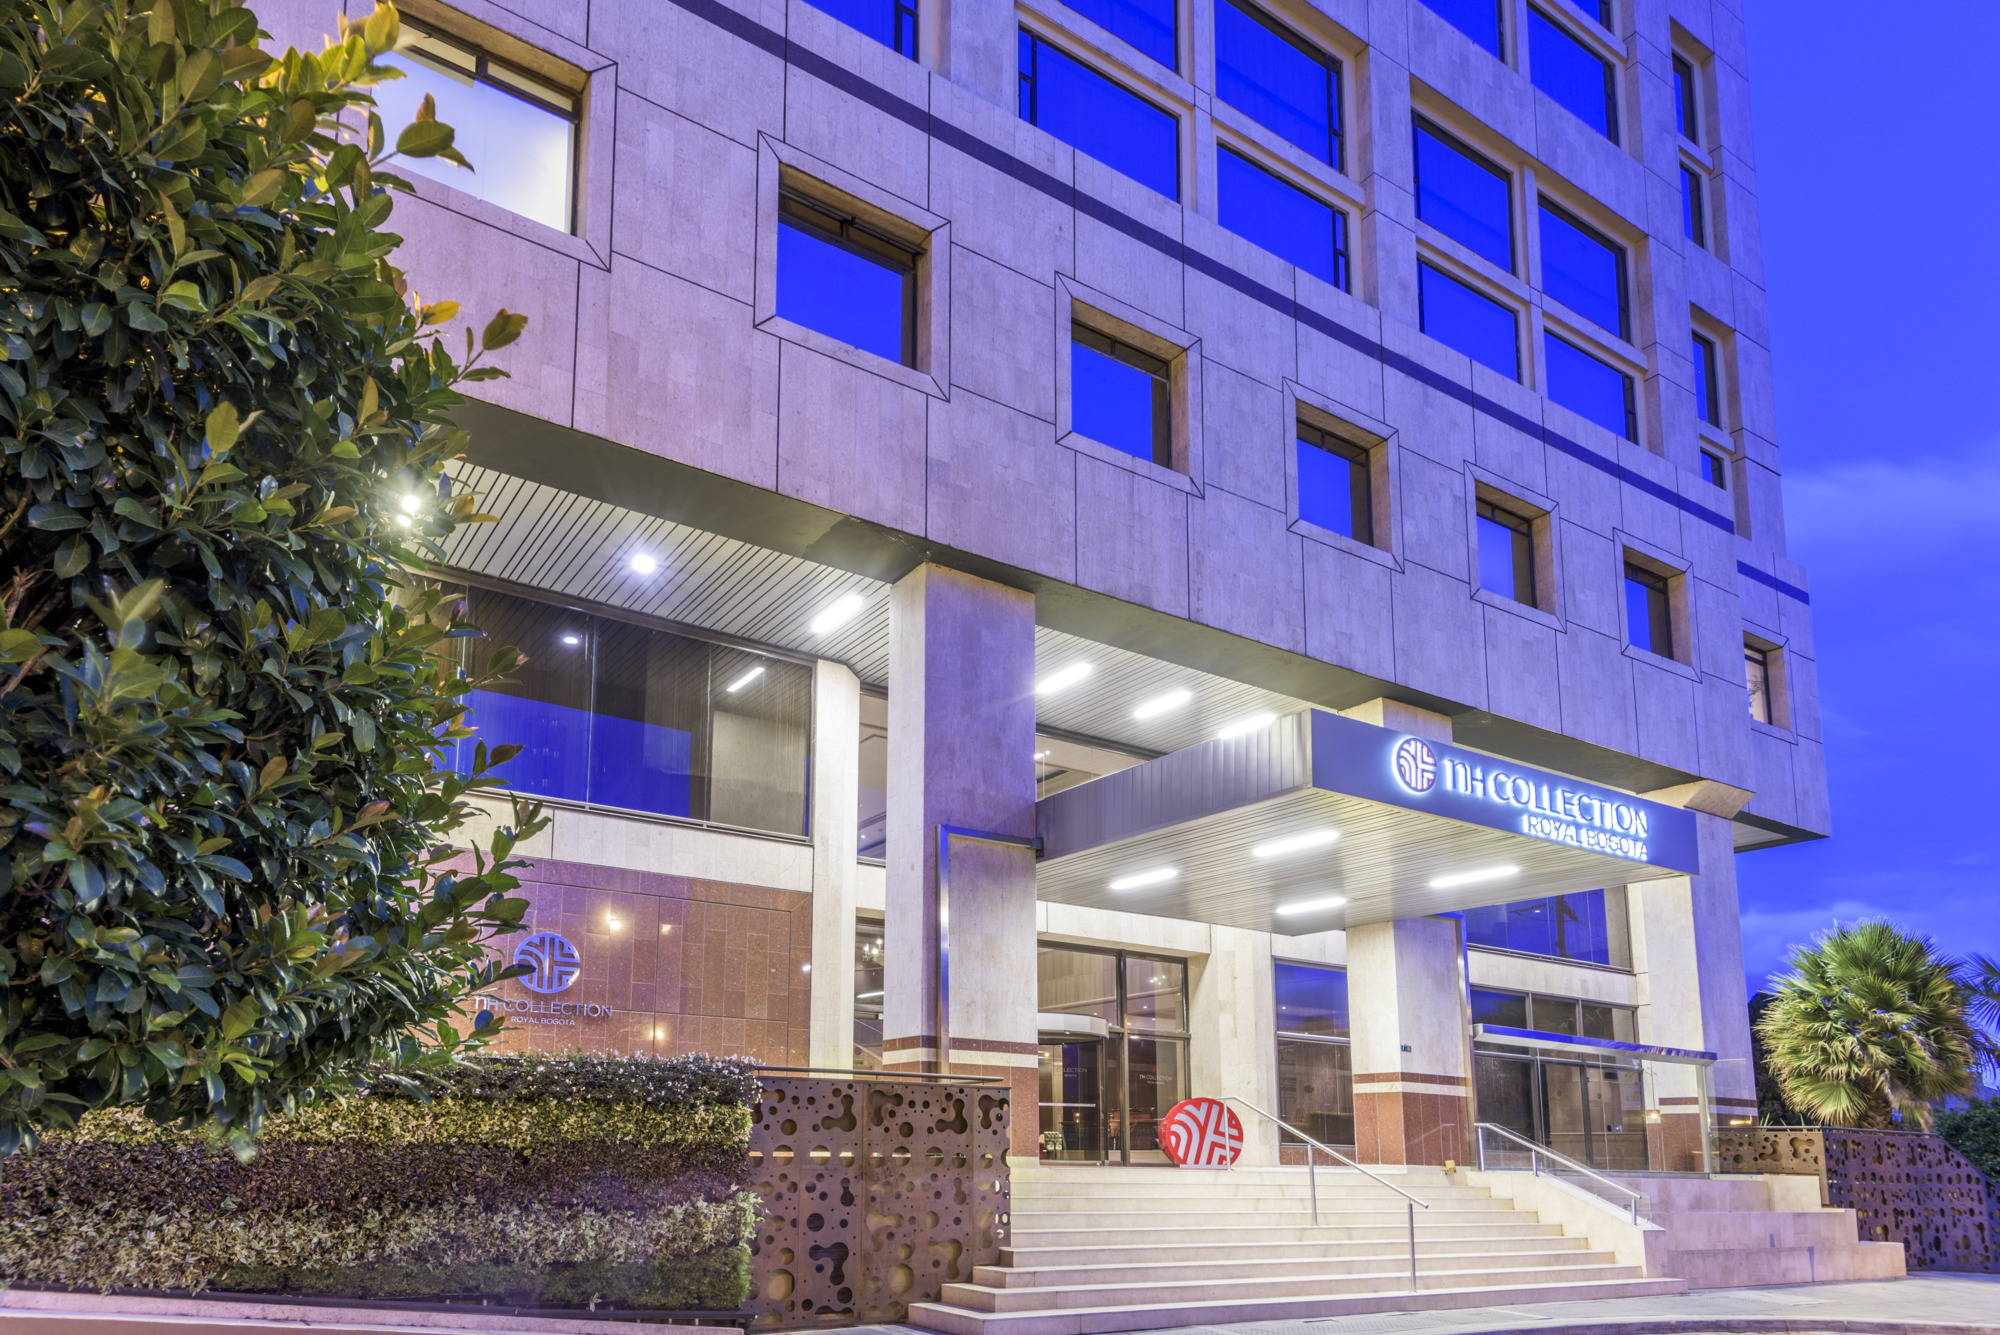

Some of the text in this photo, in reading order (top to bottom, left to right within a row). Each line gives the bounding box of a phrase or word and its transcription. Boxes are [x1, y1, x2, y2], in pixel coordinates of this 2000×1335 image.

[1488, 771, 1648, 838] COLLECTION
[1523, 814, 1648, 860] ROYAL BOGOTA
[503, 999, 613, 1017] COLLECTION
[511, 1016, 576, 1027] ROYAL BOGOTA
